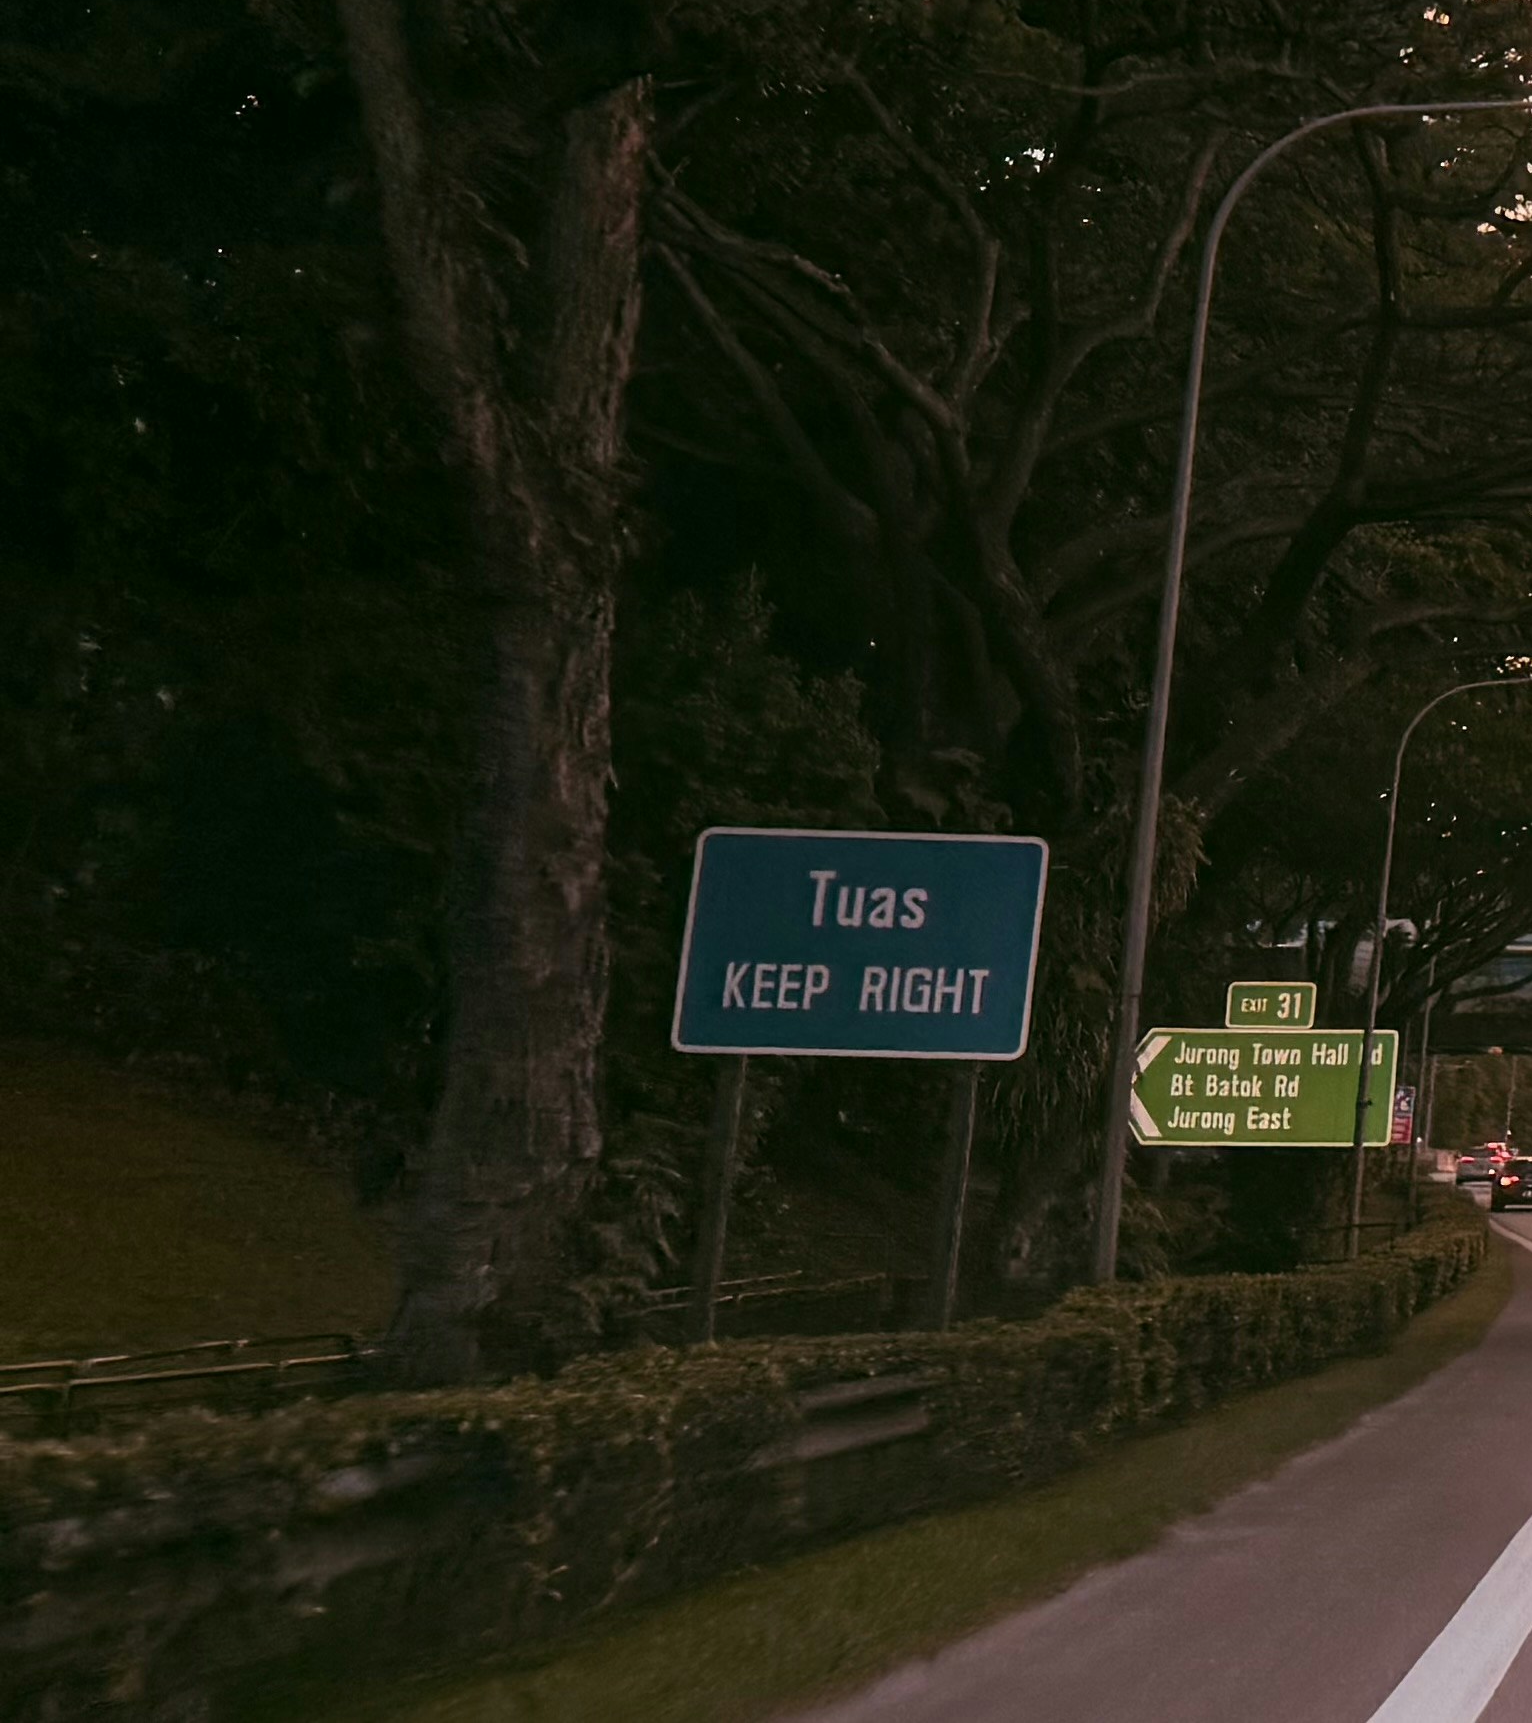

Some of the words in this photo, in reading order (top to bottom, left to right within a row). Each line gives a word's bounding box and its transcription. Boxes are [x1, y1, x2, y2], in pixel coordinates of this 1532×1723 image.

[809, 870, 929, 928] Tuas
[722, 961, 830, 1010] KEEP
[859, 966, 990, 1014] RIGHT
[1241, 998, 1268, 1013] EXIT
[1277, 992, 1302, 1019] 31
[1174, 1042, 1240, 1069] Jurong
[1252, 1043, 1301, 1065] Town
[1311, 1043, 1349, 1065] Hall
[1359, 1043, 1383, 1065] d
[1170, 1075, 1194, 1097] Bt
[1205, 1075, 1263, 1097] Batok
[1274, 1075, 1300, 1098] Rd
[1167, 1107, 1235, 1135] Jurong
[1246, 1107, 1291, 1130] East
